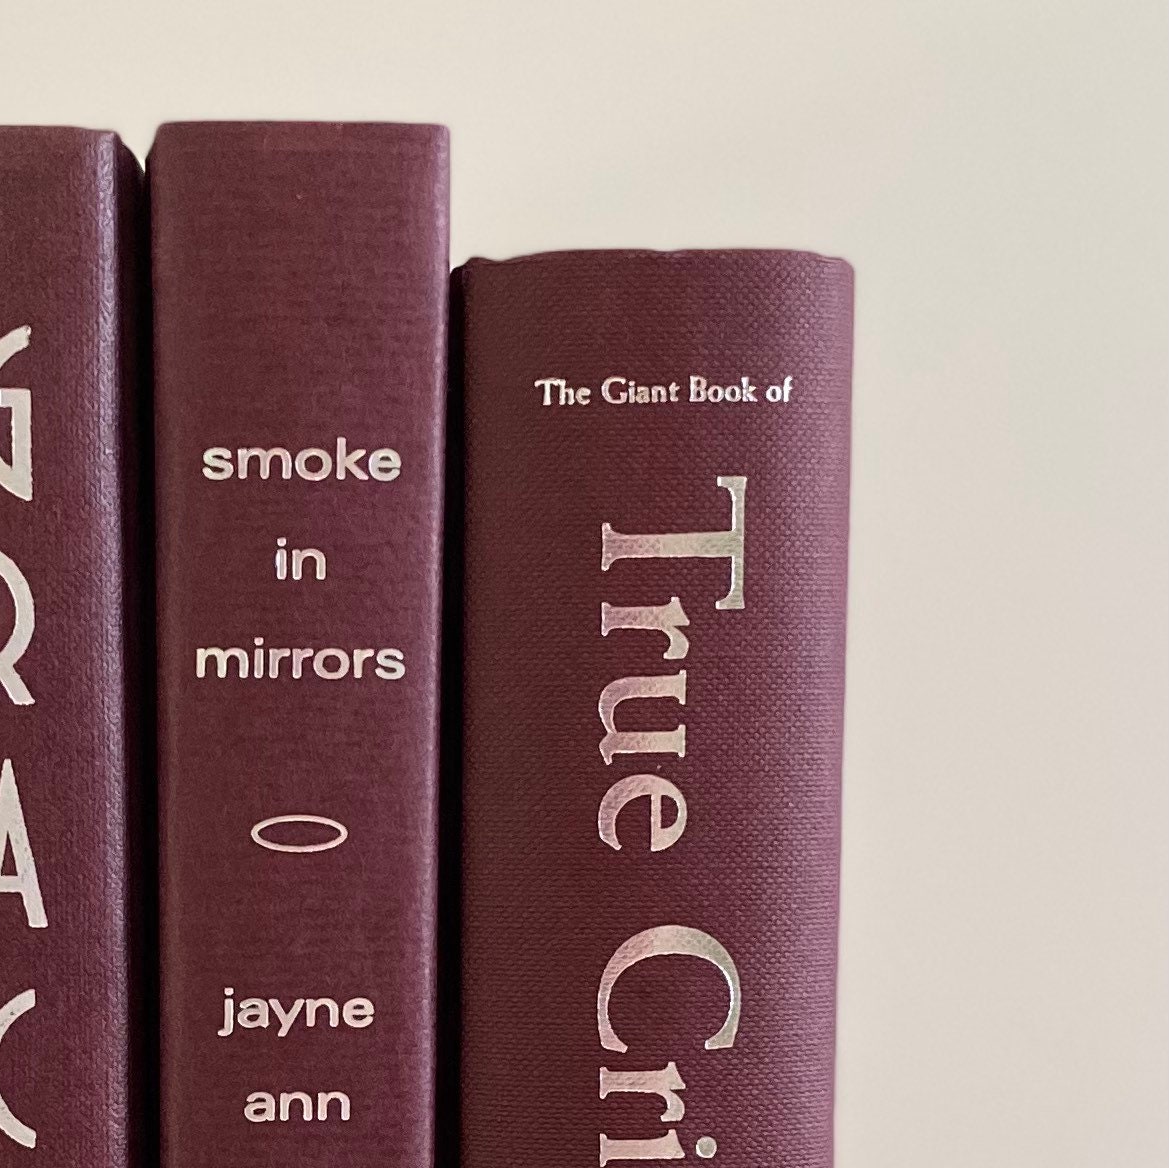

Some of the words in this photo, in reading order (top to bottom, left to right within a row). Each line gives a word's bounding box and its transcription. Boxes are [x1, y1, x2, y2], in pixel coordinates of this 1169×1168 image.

[535, 377, 590, 405] The
[601, 376, 681, 405] Giant
[689, 375, 759, 403] Book
[766, 375, 794, 403] of
[202, 436, 402, 482] smoke
[275, 537, 327, 581] in
[196, 636, 406, 680] mirrors
[598, 475, 748, 852] True
[217, 987, 375, 1037] jayne
[243, 1091, 351, 1123] ann
